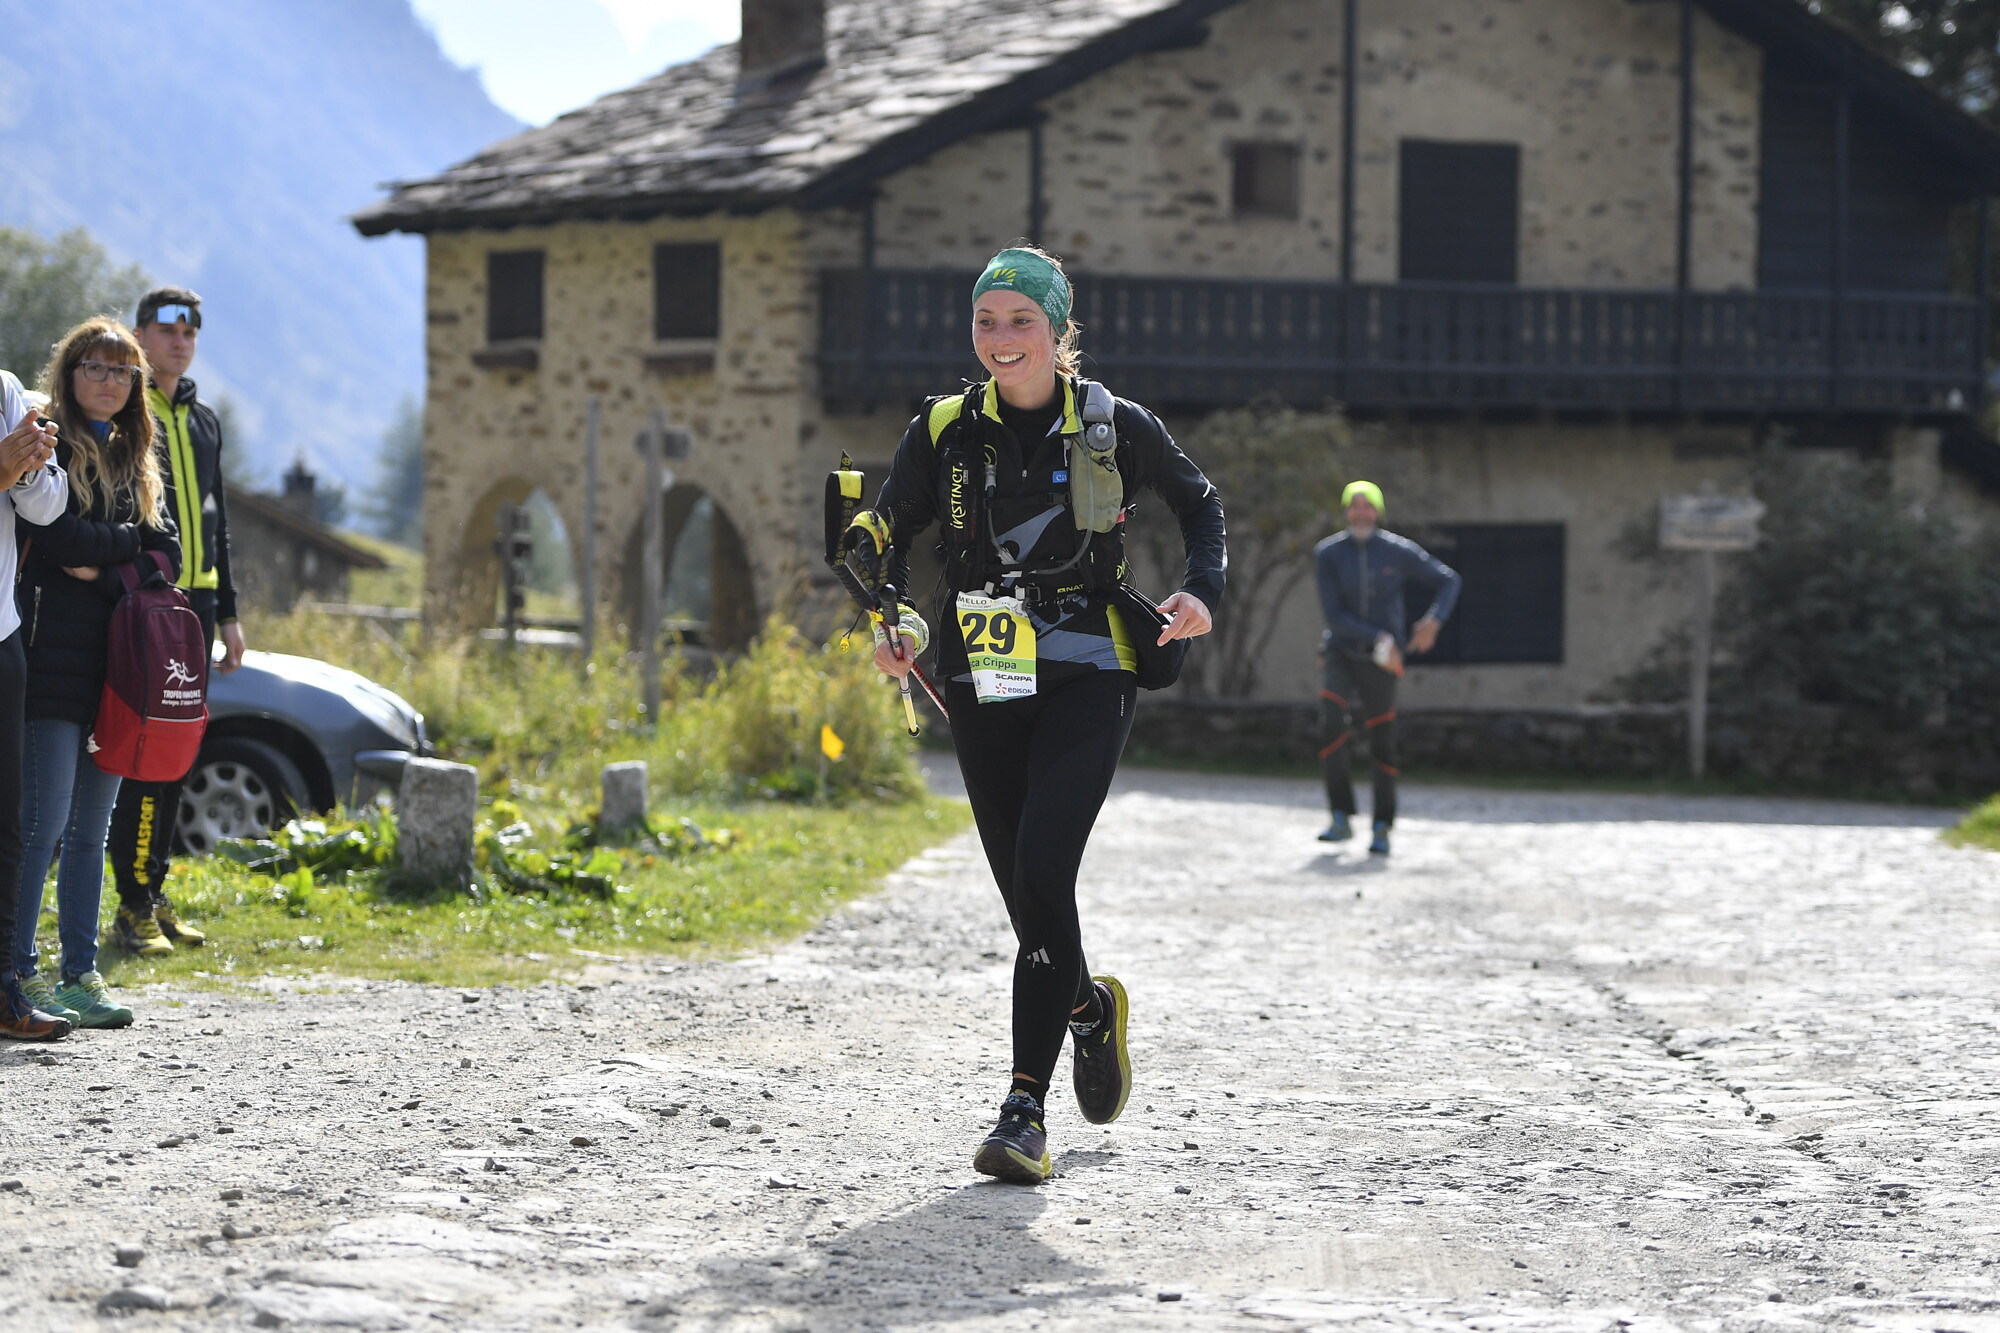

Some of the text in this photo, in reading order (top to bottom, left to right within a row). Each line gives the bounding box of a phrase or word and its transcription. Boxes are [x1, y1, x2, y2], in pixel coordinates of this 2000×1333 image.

[958, 595, 987, 605] MELLO
[962, 612, 1017, 655] 29
[983, 657, 1017, 670] Crippa
[995, 673, 1033, 682] SCARPA
